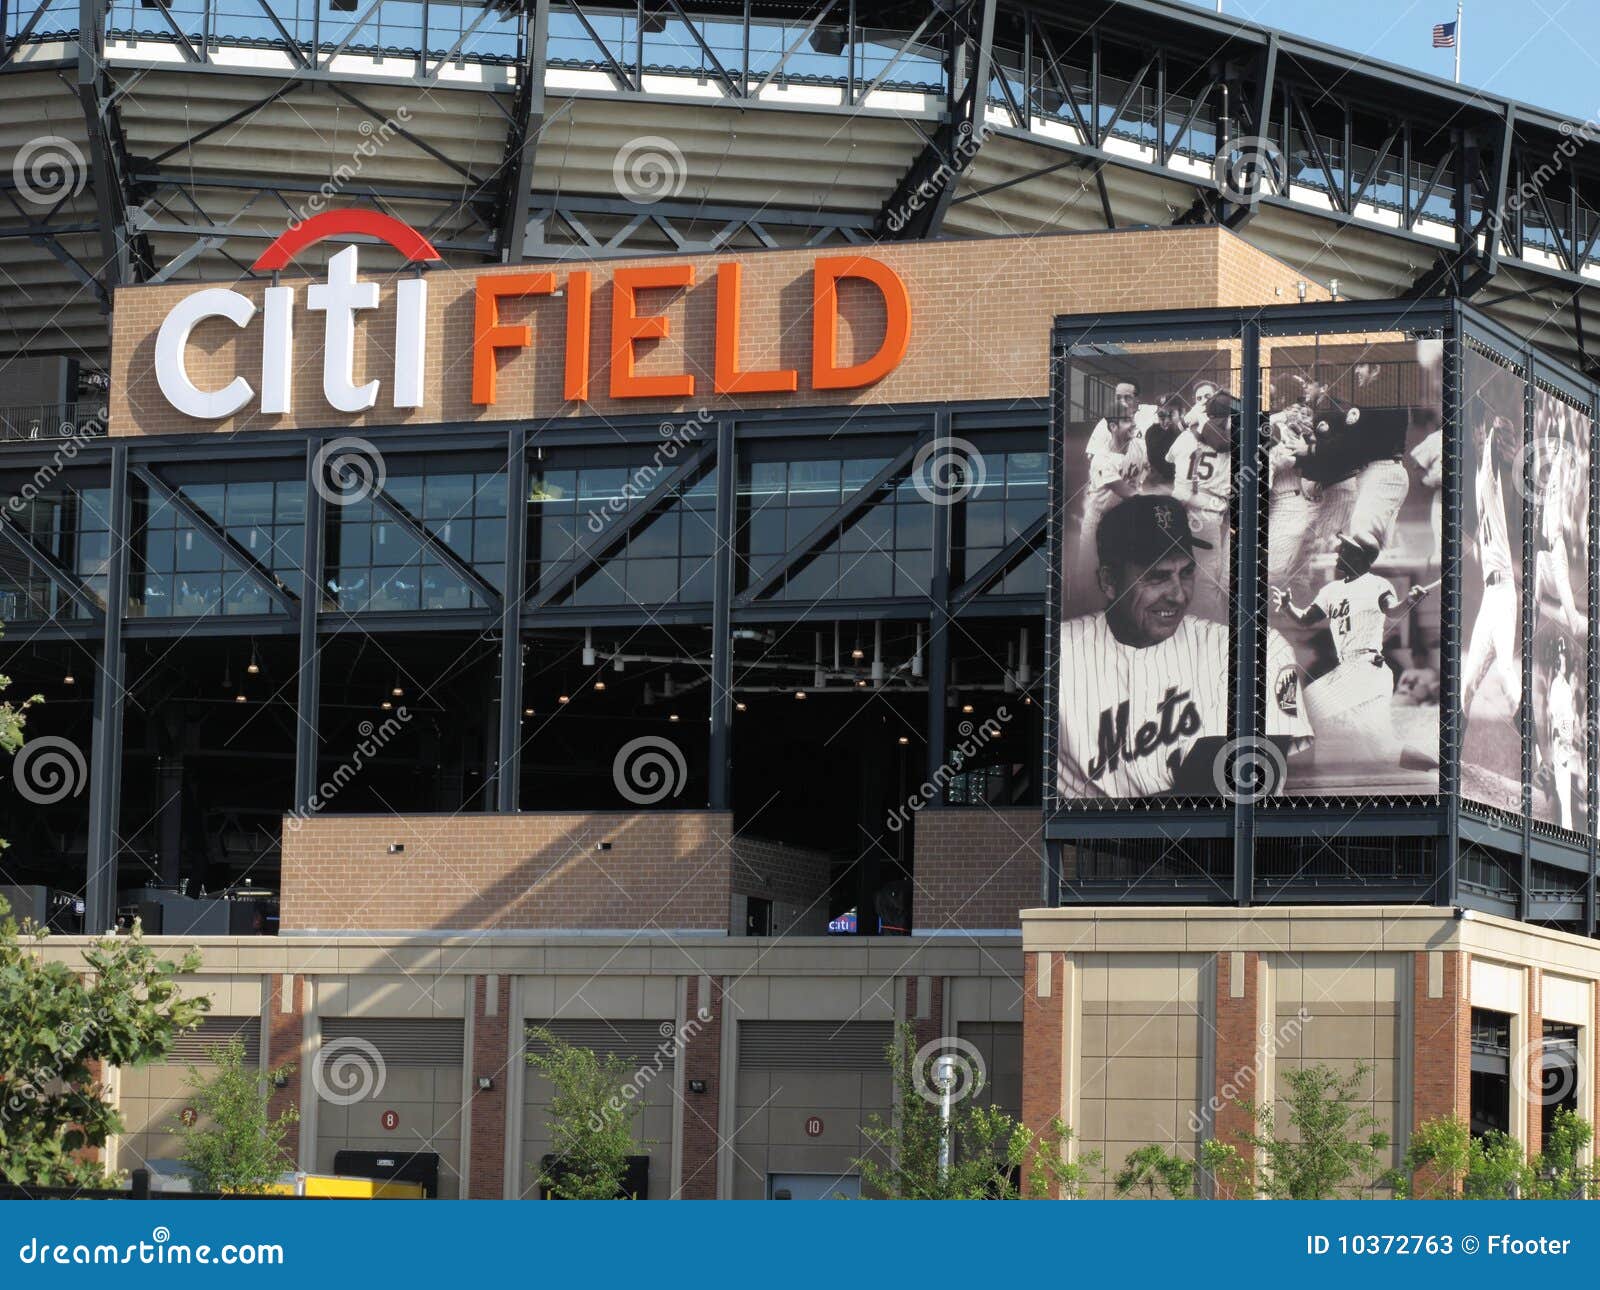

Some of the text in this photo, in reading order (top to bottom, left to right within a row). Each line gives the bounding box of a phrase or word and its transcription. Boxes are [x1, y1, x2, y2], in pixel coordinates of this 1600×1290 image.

[155, 244, 912, 419] citi FIELD
[1186, 448, 1218, 481] 15
[1088, 685, 1201, 781] Mets
[386, 1114, 394, 1127] 8
[809, 1120, 820, 1134] 10
